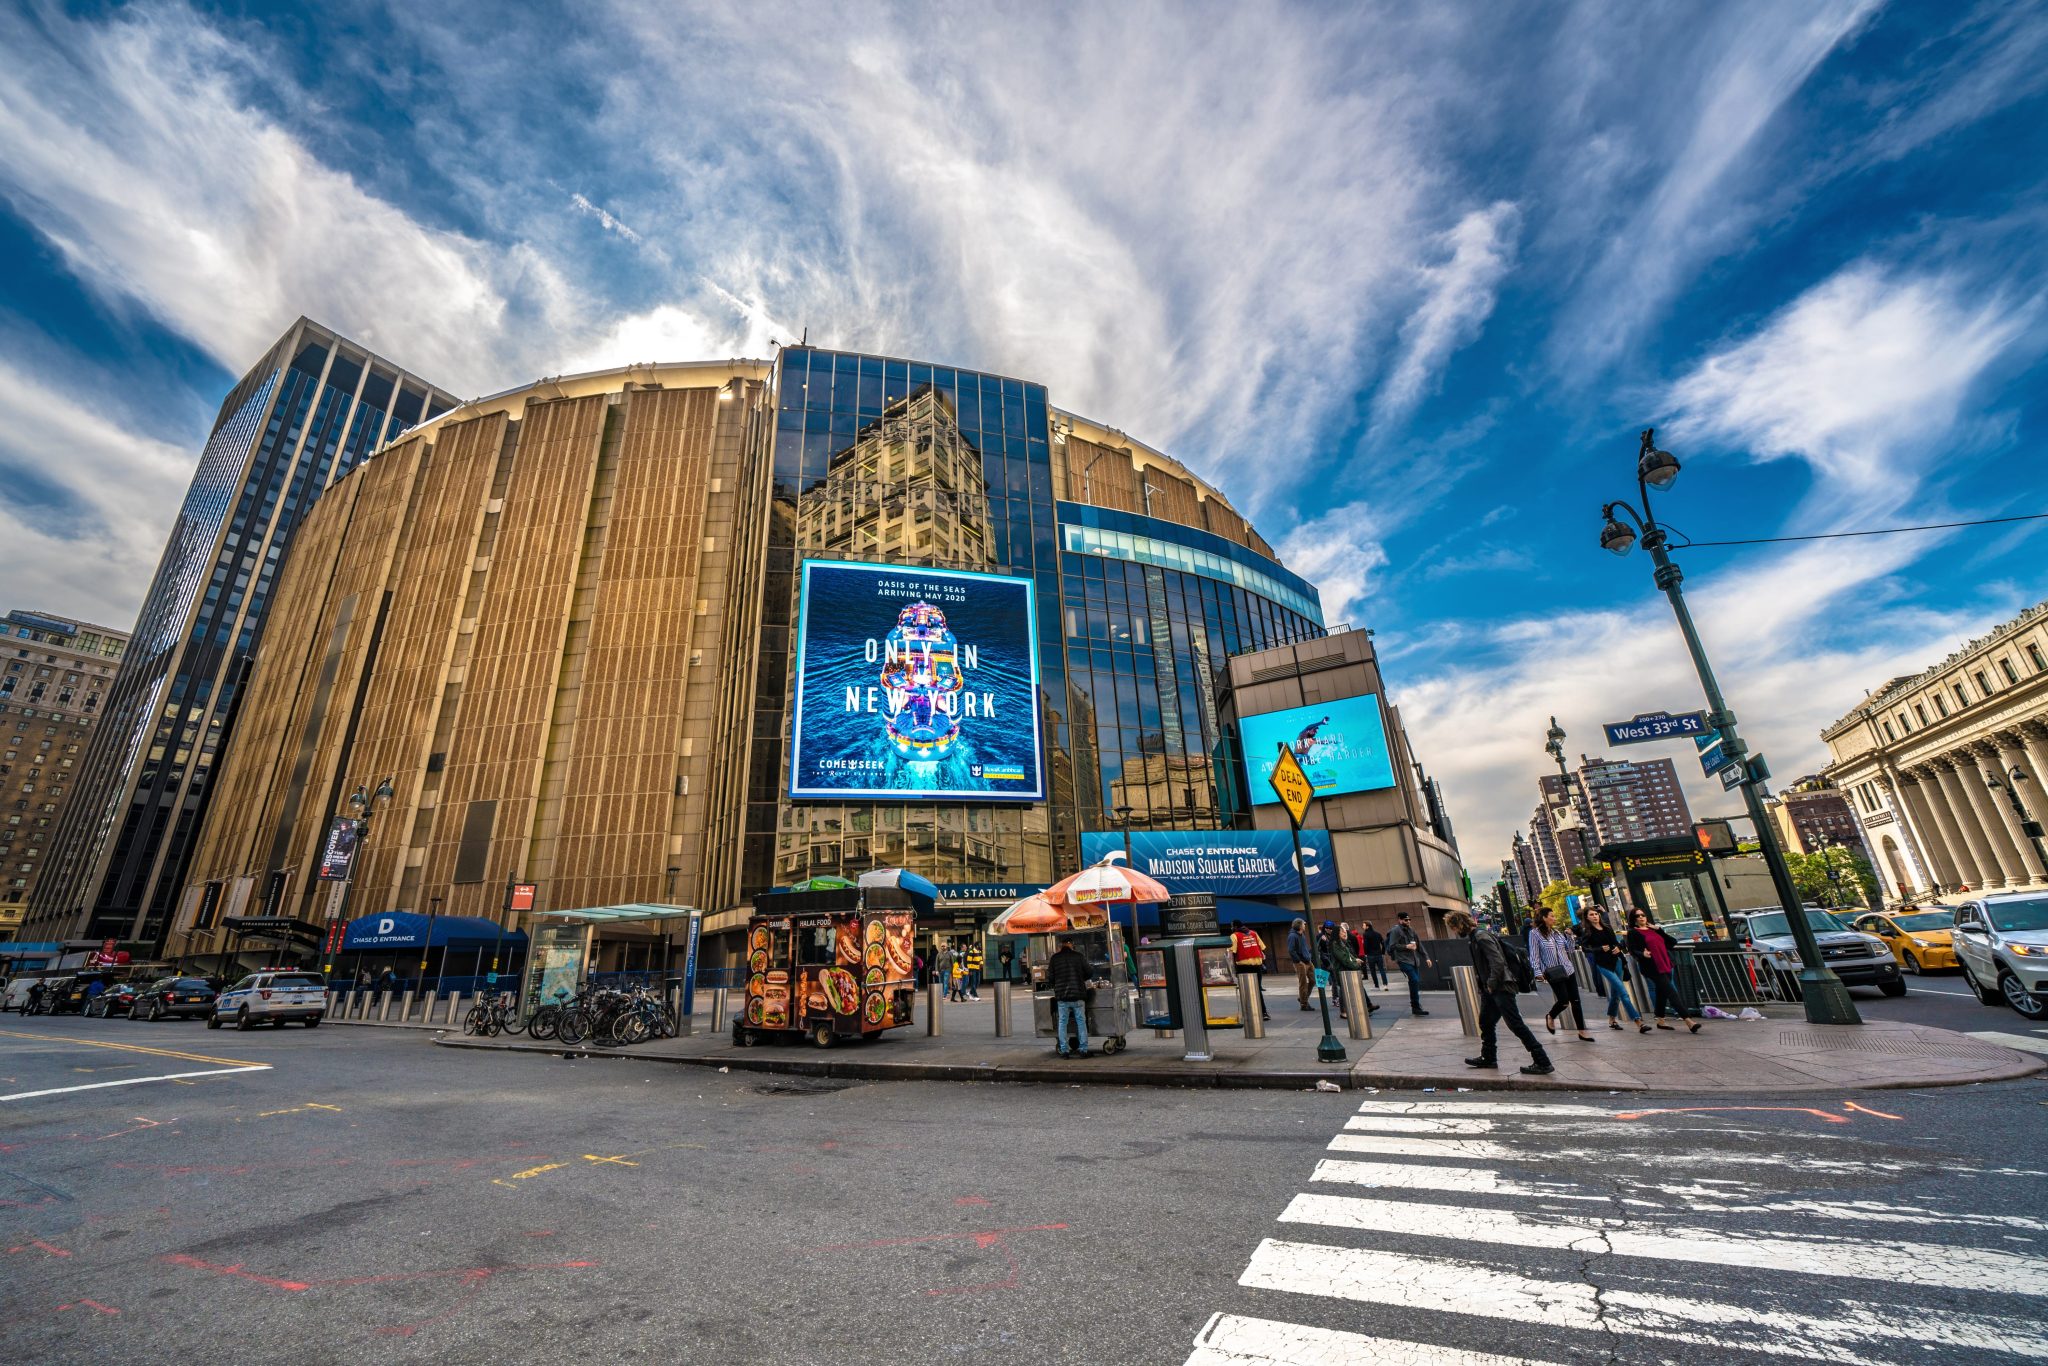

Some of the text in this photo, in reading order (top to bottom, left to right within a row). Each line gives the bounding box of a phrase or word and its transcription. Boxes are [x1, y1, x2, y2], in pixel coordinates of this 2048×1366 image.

[878, 580, 966, 594] OASIS OF THE SEAS
[877, 588, 966, 602] ARRIVING MAY 2020
[865, 638, 978, 669] ONLY IN
[845, 686, 996, 718] NEW YORK
[1614, 718, 1699, 740] West 33rd St
[819, 759, 885, 770] COME SEEK
[1280, 769, 1303, 786] DEAD
[1286, 788, 1303, 804] END
[1166, 847, 1258, 856] CHASE ENTRANCE
[1149, 858, 1195, 875] MADISON
[1198, 857, 1235, 874] SQUARE
[1291, 847, 1320, 876] C
[963, 889, 1016, 898] STATION
[1076, 889, 1097, 902] NUTS
[1101, 887, 1123, 899] NUTS
[1168, 895, 1213, 907] PENN STATION
[378, 918, 395, 935] D
[800, 918, 832, 928] HALAL FOOD
[353, 935, 416, 944] CHASE ENTRANCE
